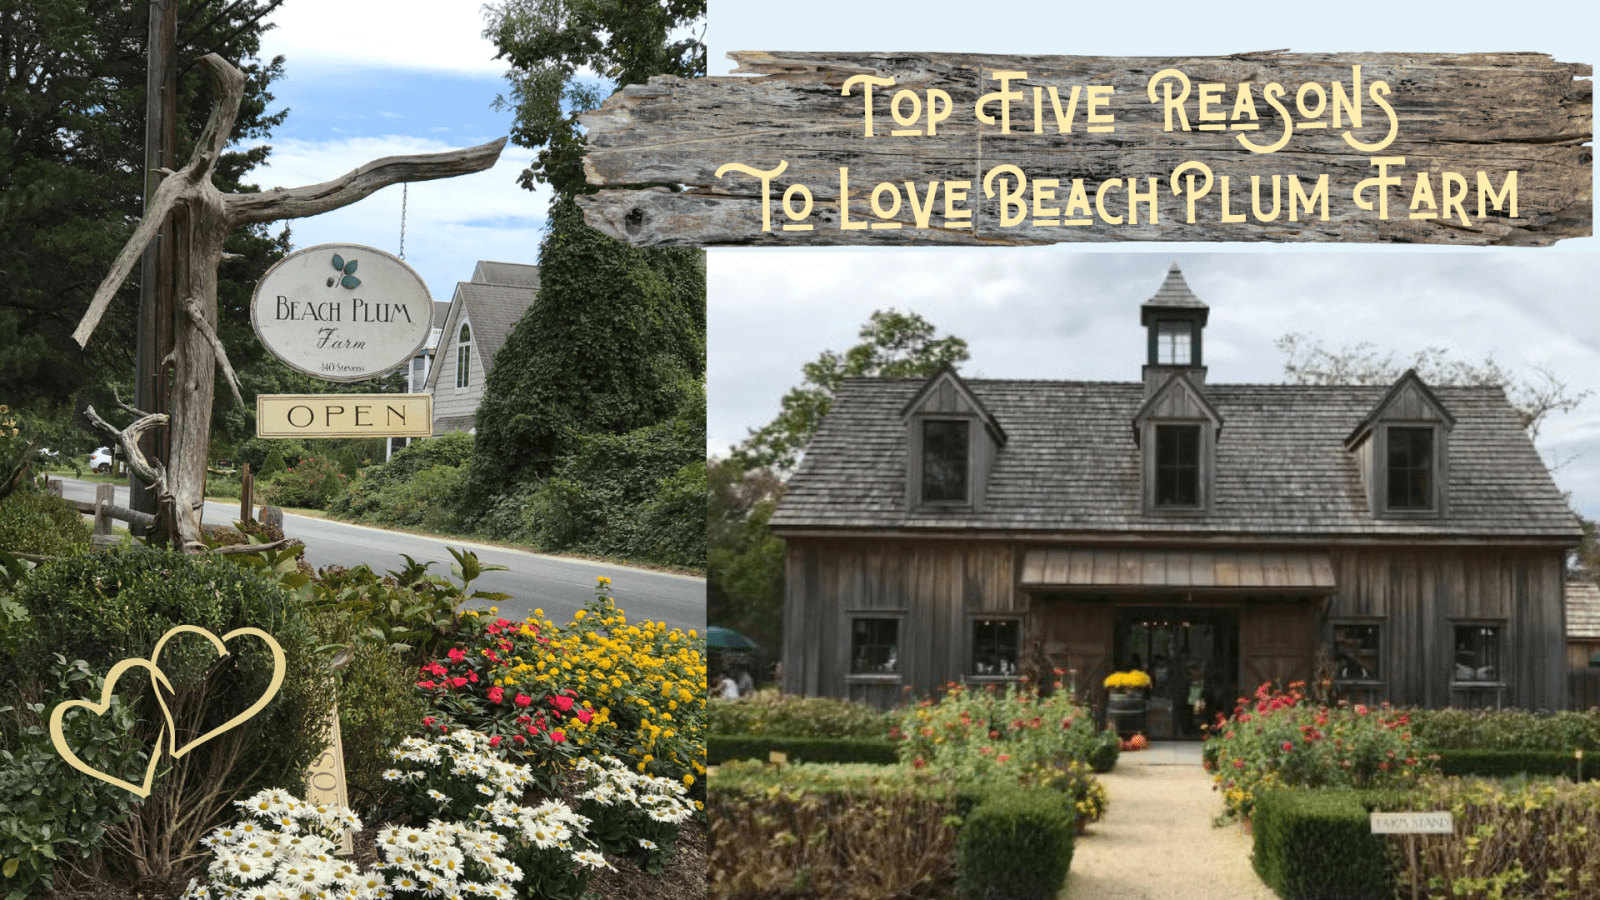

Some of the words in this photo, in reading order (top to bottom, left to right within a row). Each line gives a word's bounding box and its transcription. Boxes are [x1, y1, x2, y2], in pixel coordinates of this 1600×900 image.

[275, 295, 341, 322] BEACH
[352, 298, 413, 323] PLUM
[316, 326, 366, 350] Farm
[336, 362, 366, 372] Stevens
[287, 404, 406, 428] OPEN
